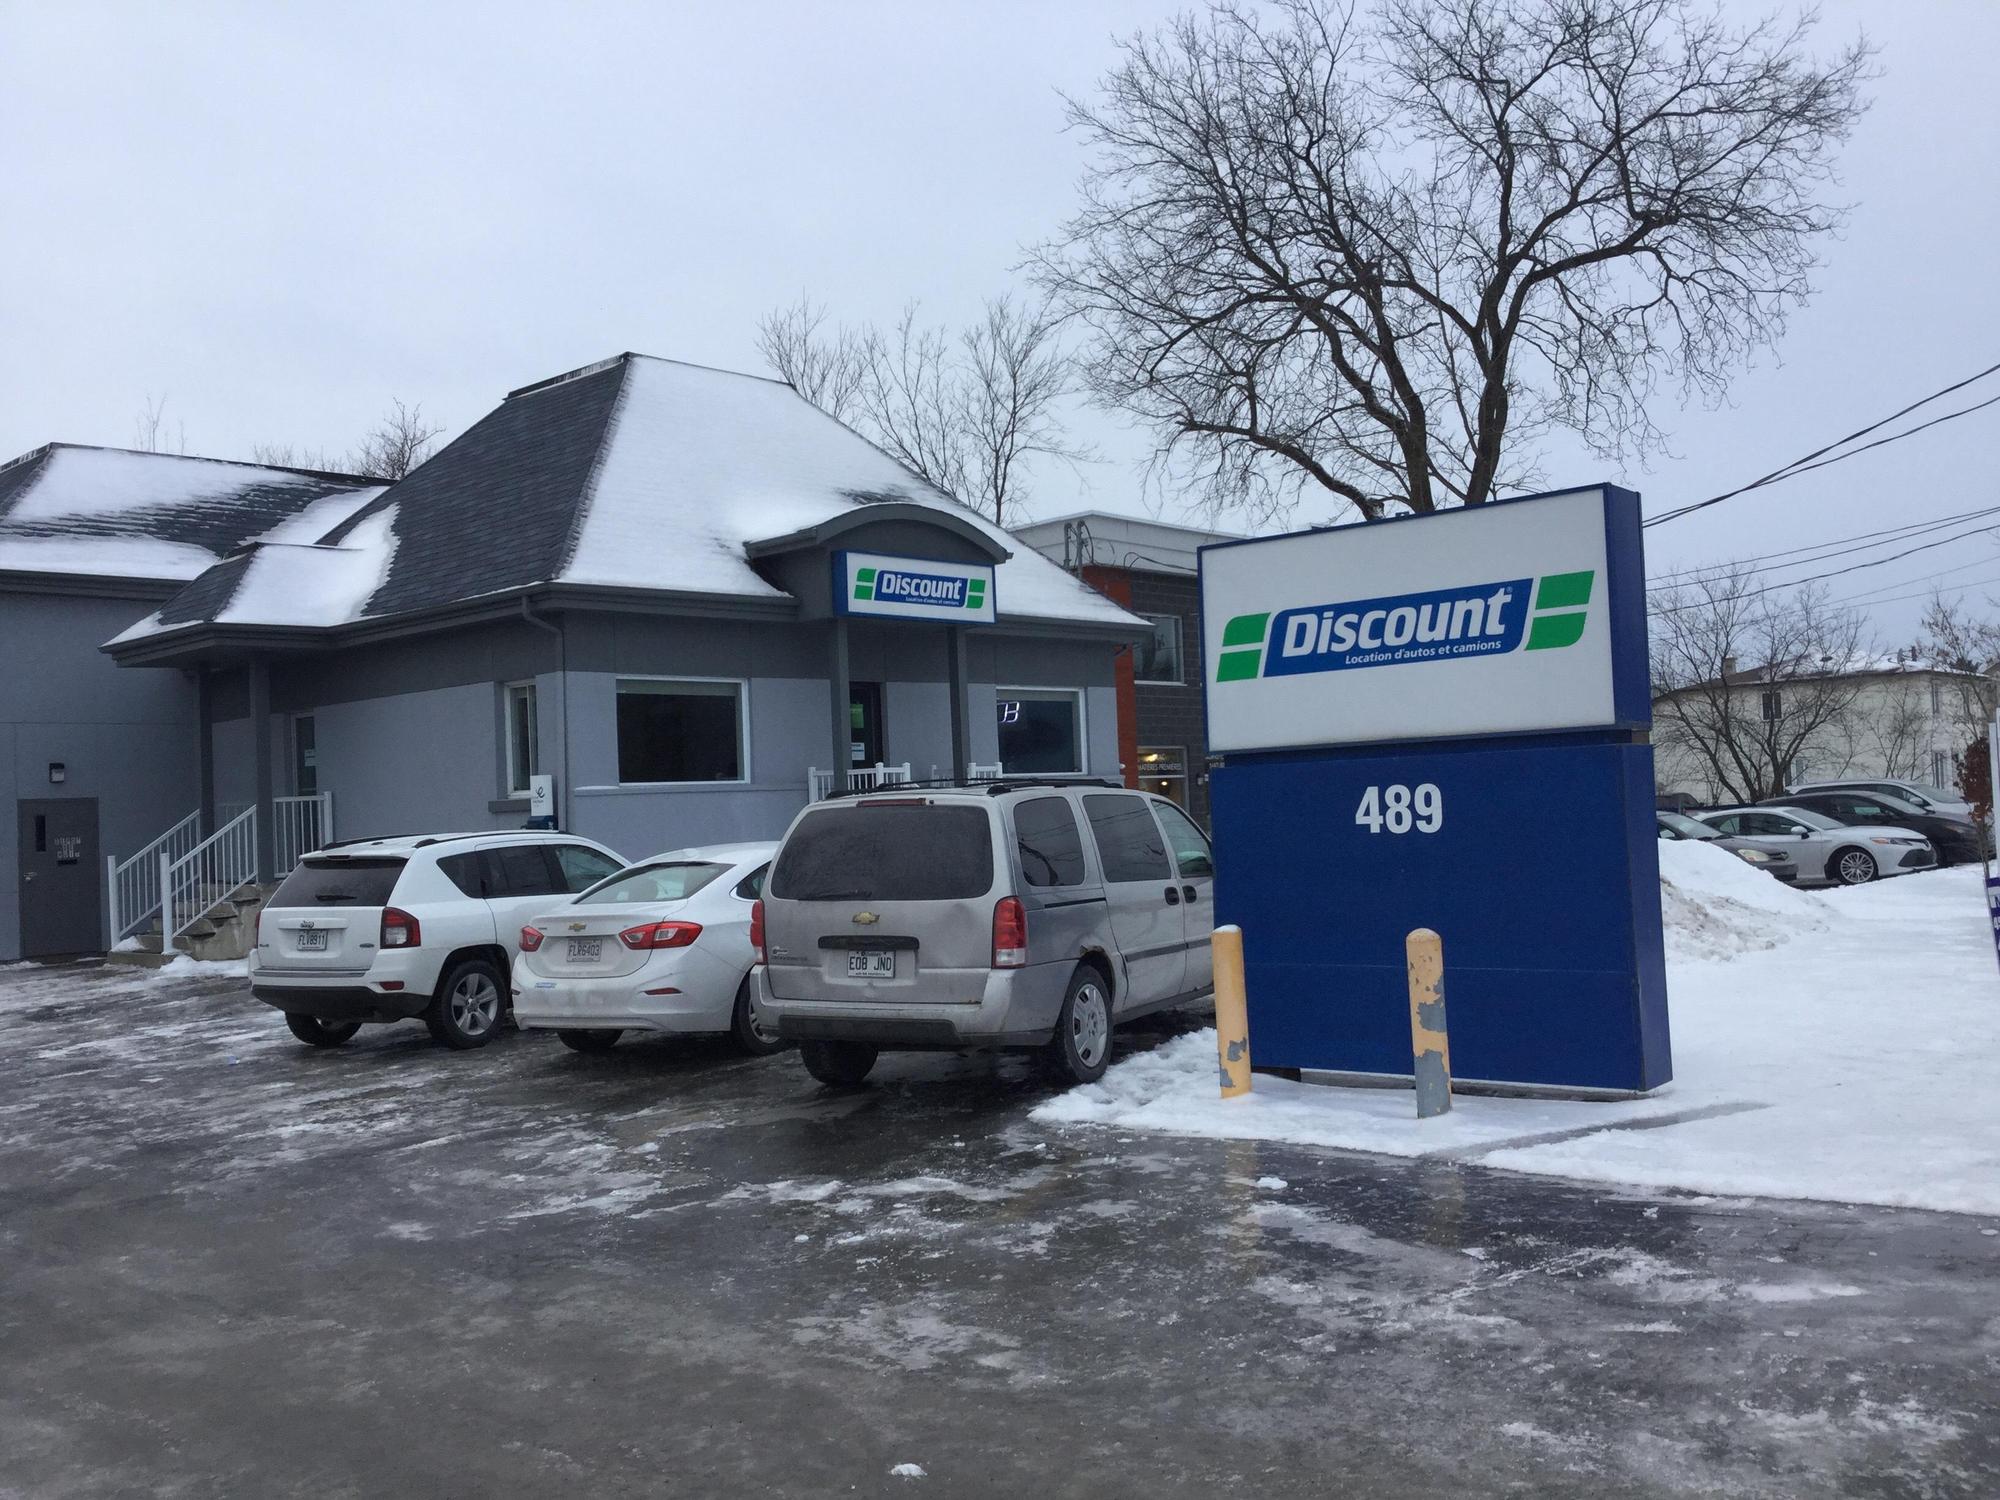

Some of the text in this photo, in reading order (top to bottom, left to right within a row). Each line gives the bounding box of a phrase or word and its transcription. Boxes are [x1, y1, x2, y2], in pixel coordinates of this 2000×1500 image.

[881, 573, 962, 600] Discount
[1282, 587, 1512, 657] Discount
[1345, 640, 1502, 665] Location d'autos et camions
[1355, 783, 1443, 834] 489
[873, 957, 892, 971] JND
